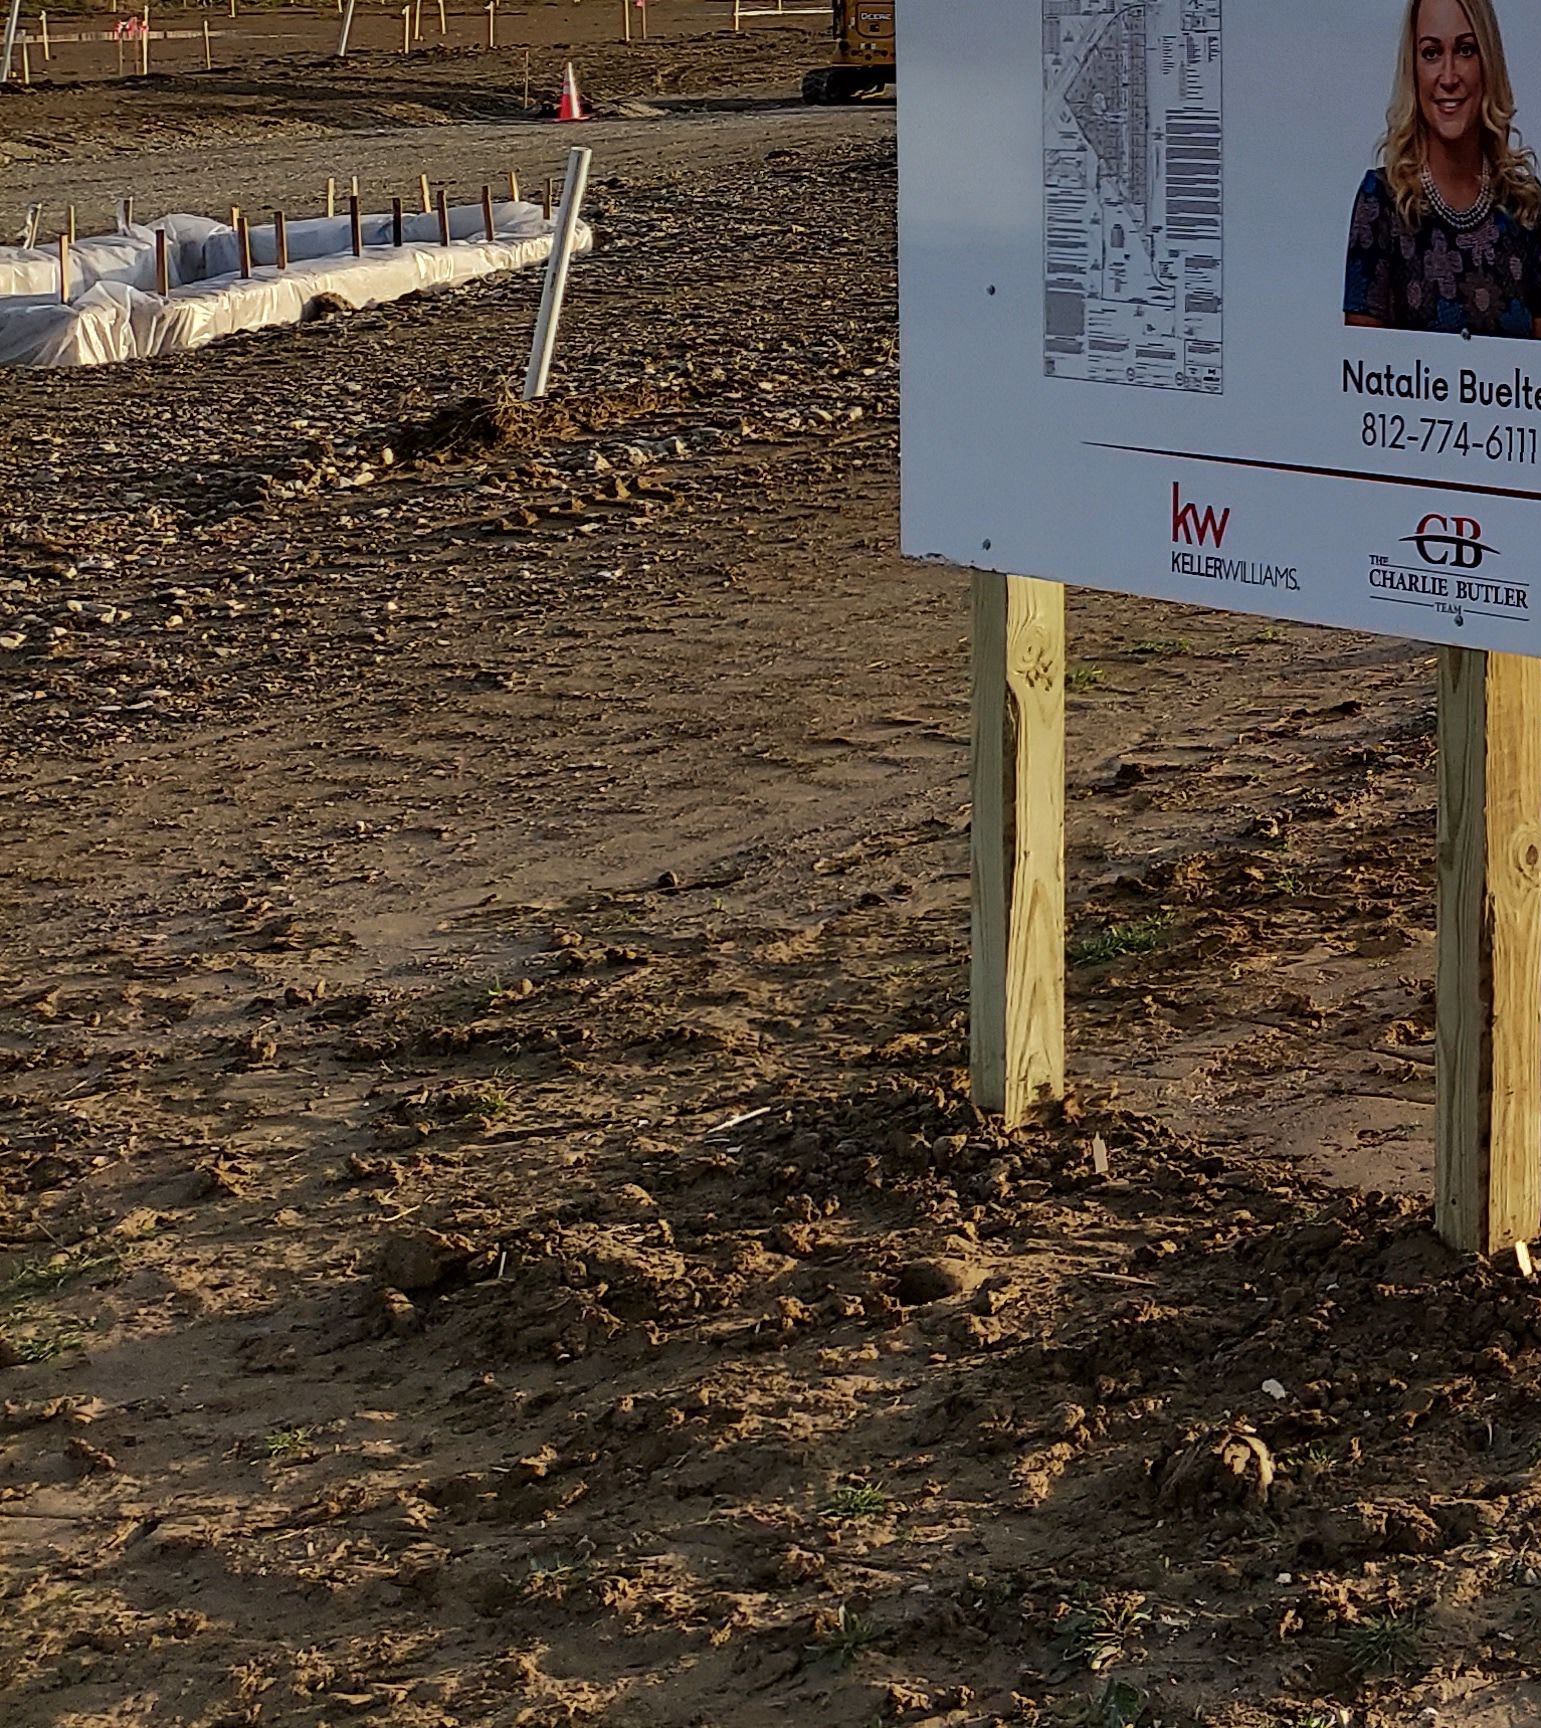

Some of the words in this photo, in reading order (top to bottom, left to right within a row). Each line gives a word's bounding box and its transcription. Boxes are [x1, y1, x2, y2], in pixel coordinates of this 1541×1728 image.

[1342, 359, 1450, 403] Natalie
[1361, 413, 1538, 464] 812-774-6111
[1369, 554, 1389, 565] THE
[1415, 513, 1484, 568] CB
[1369, 569, 1449, 596] CHARLIE
[1456, 581, 1528, 610] BUTLER
[1435, 601, 1462, 615] TEAM
